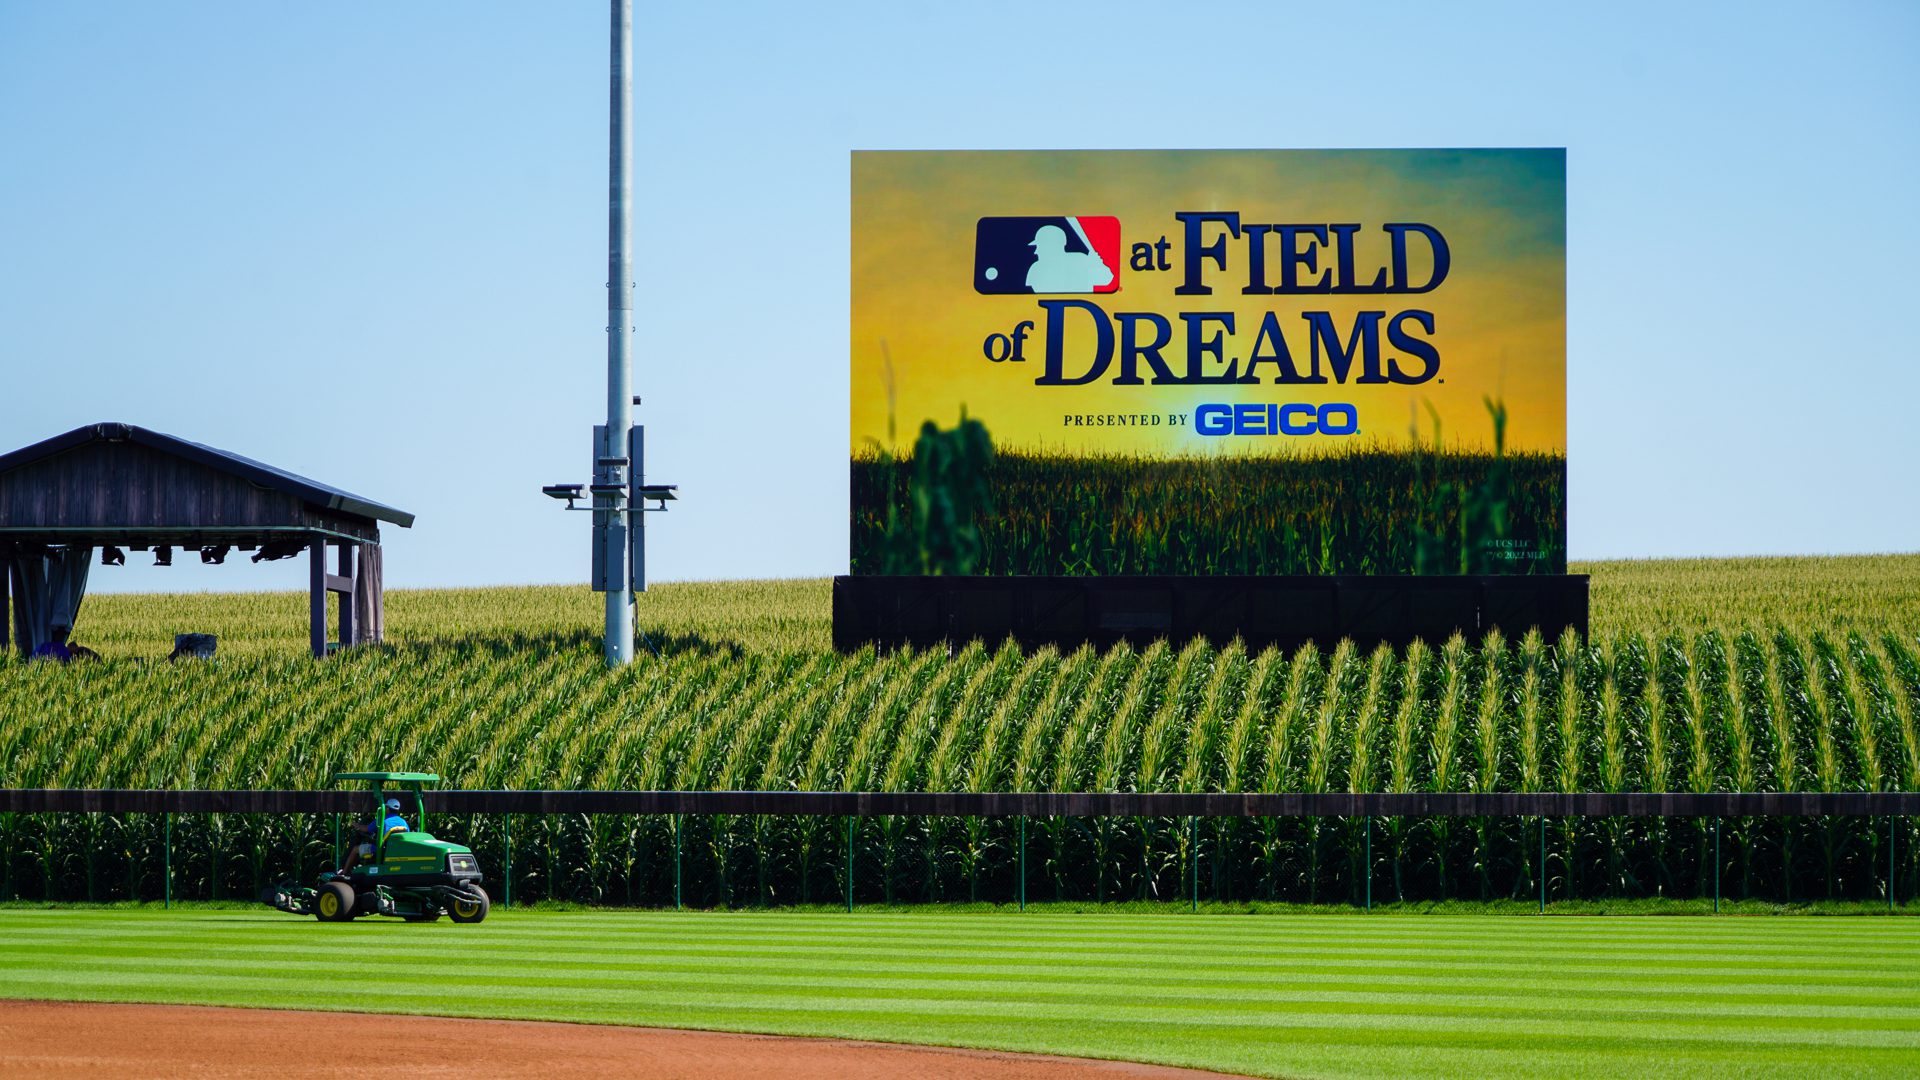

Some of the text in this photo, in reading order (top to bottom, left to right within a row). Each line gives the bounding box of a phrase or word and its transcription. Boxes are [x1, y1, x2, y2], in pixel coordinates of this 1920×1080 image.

[1130, 211, 1451, 295] at FIELD
[983, 299, 1441, 385] of DREAMS
[1063, 403, 1357, 436] PRESENTED BY GEICO
